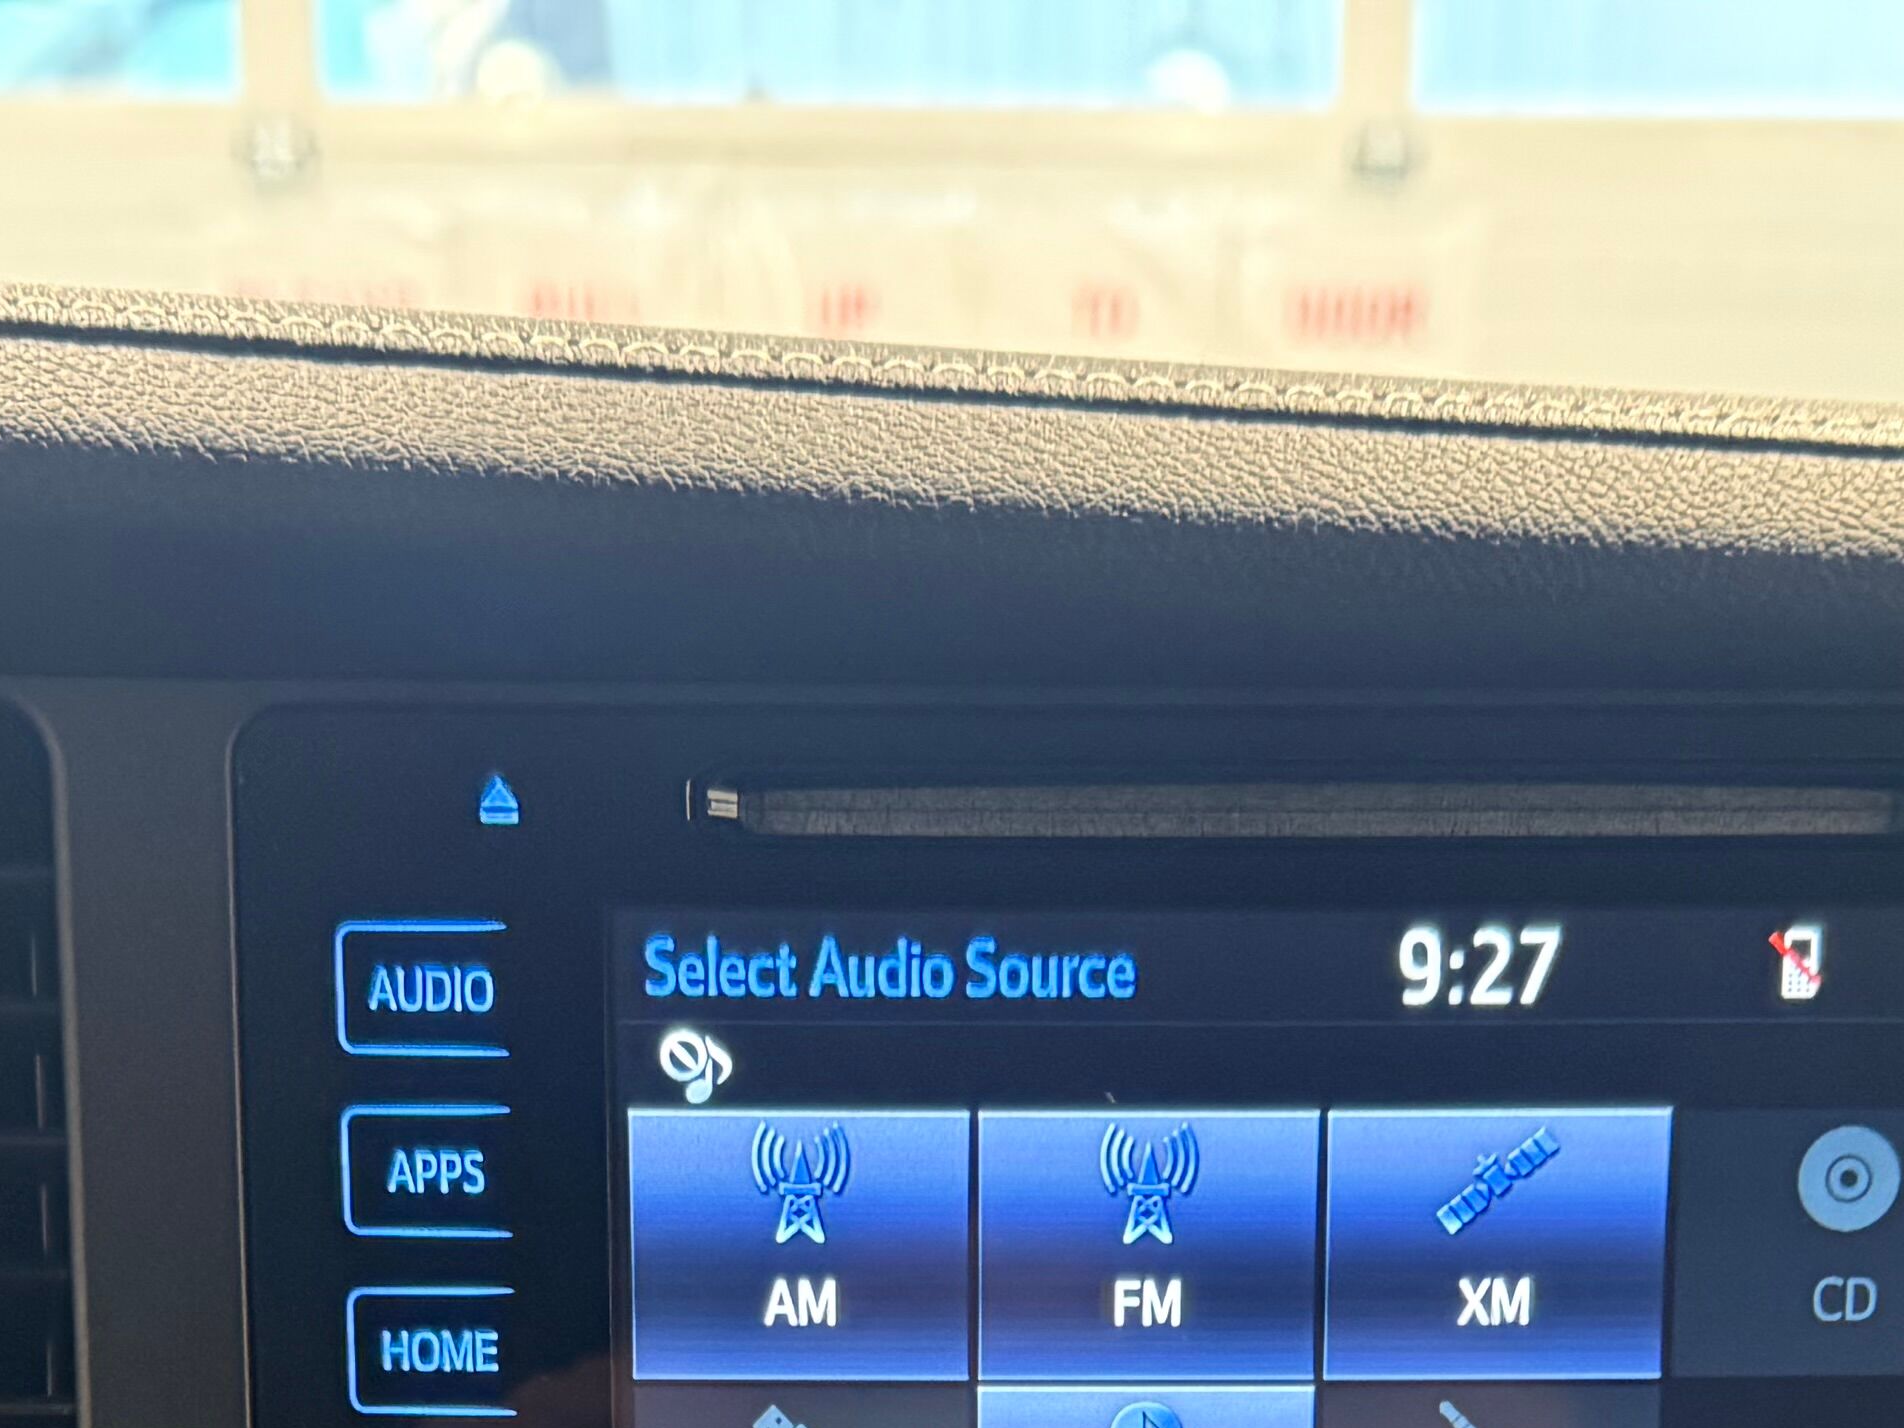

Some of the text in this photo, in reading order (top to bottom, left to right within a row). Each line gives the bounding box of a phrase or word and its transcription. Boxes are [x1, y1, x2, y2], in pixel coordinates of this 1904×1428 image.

[368, 965, 495, 1014] AUDIO
[643, 934, 1137, 1000] Select Audio Source
[1398, 925, 1562, 1005] 9:27
[386, 1150, 486, 1194] APPS
[763, 1278, 838, 1328] AM
[1113, 1278, 1182, 1328] FM
[1456, 1276, 1532, 1327] XM
[1812, 1276, 1878, 1322] CD
[382, 1330, 500, 1372] HOME
